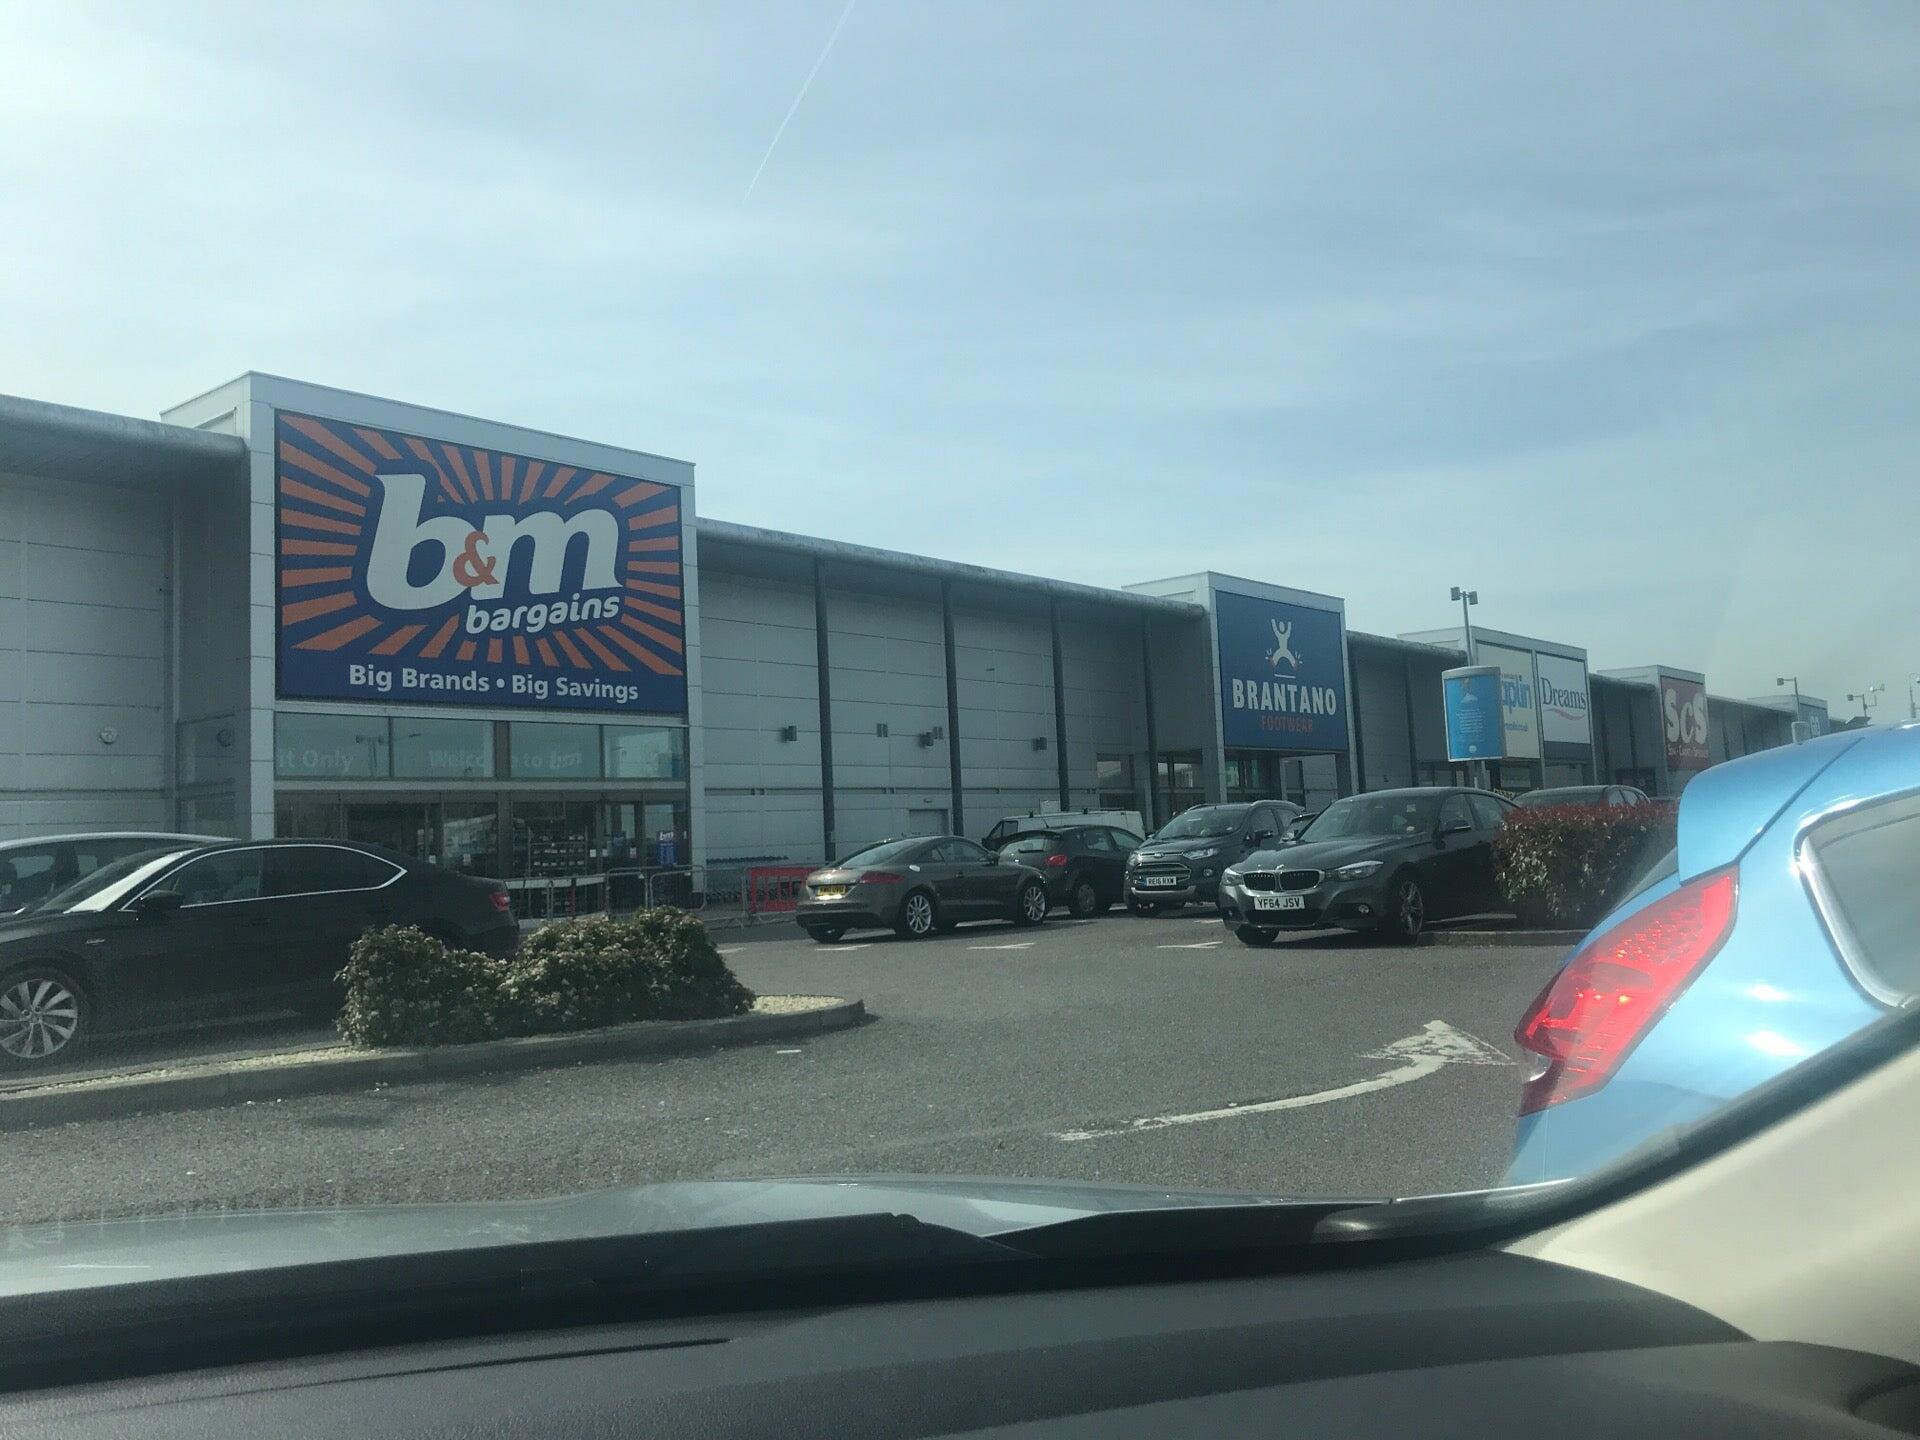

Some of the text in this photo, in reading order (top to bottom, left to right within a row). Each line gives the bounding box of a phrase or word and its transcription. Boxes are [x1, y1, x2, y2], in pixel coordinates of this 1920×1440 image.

[366, 473, 623, 610] b&m
[465, 592, 620, 635] bargains
[349, 663, 639, 703] Big Brands Big Savings
[1232, 678, 1337, 715] BRANTANO
[1541, 677, 1587, 711] Dreams
[1261, 715, 1313, 732] FOOTWEAR
[1258, 896, 1300, 909] YF64 JSV
